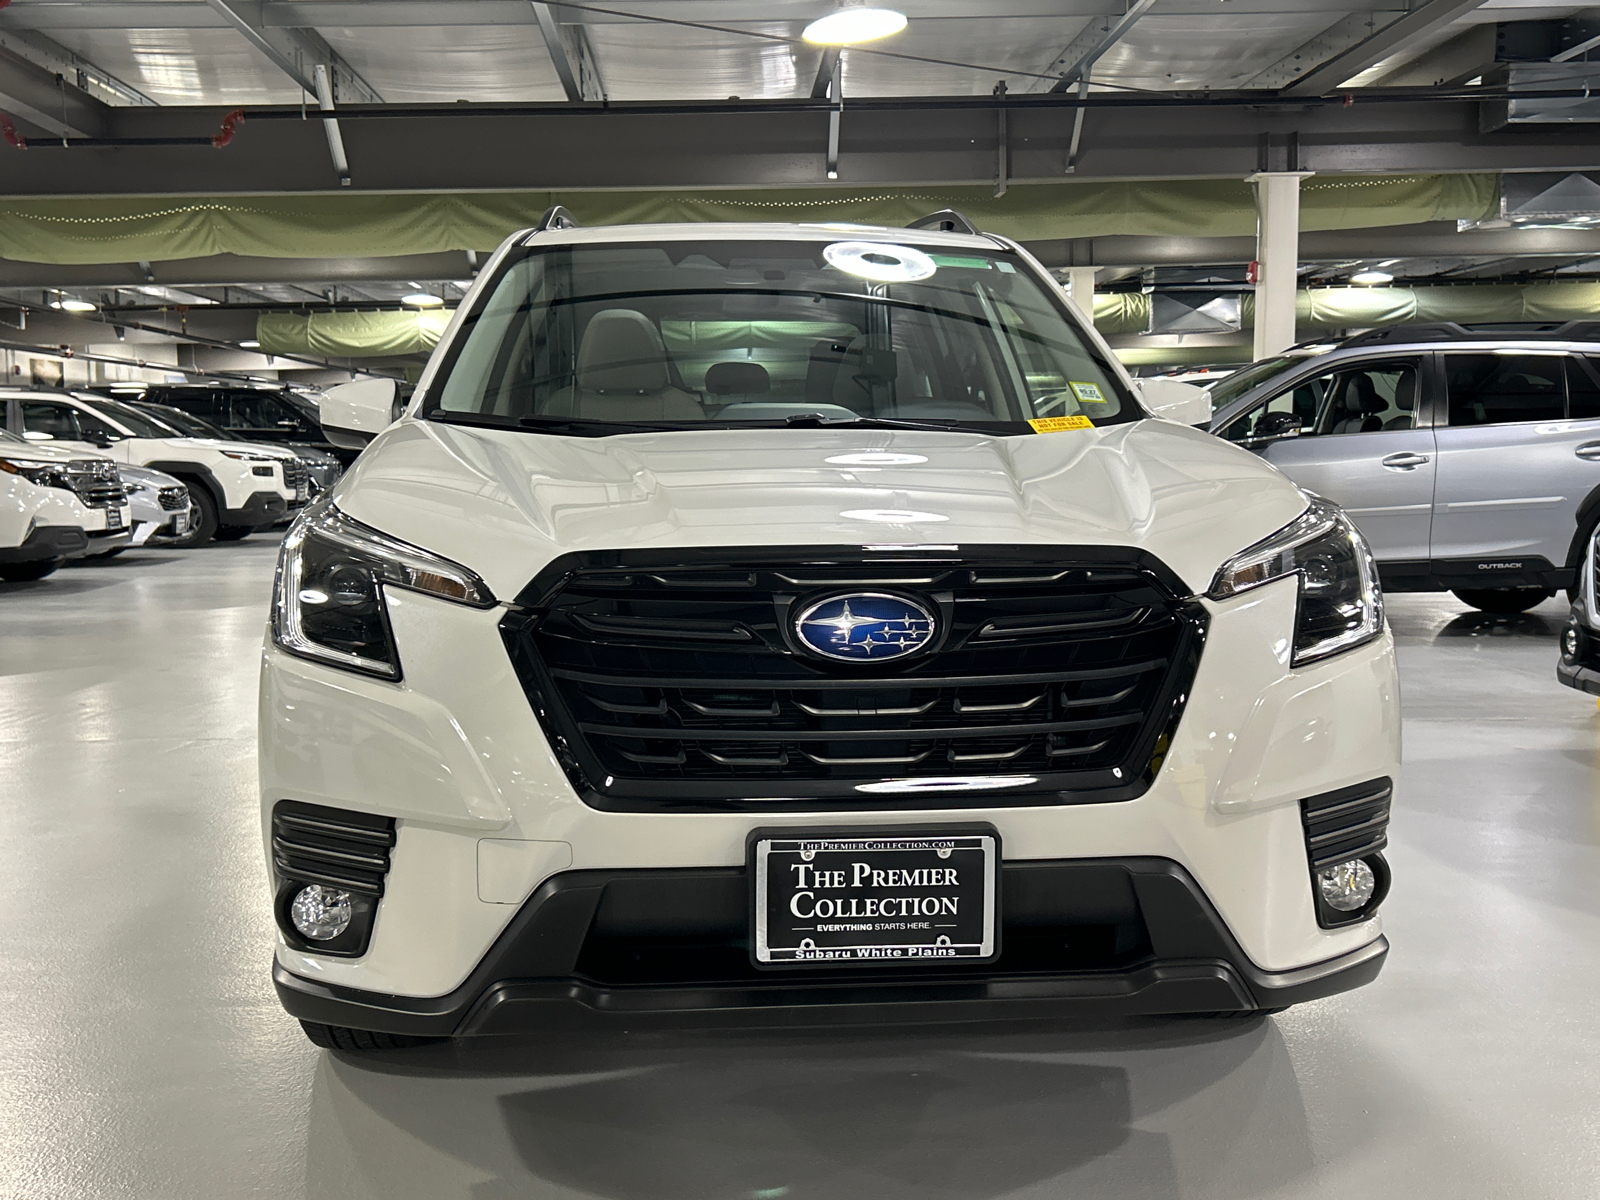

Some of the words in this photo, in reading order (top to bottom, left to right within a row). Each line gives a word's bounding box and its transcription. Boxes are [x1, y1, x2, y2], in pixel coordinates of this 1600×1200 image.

[816, 923, 873, 932] EVERYTHING
[874, 922, 906, 930] STARTS
[795, 949, 851, 959] Subaru
[857, 948, 902, 957] White
[908, 947, 956, 957] Plains
